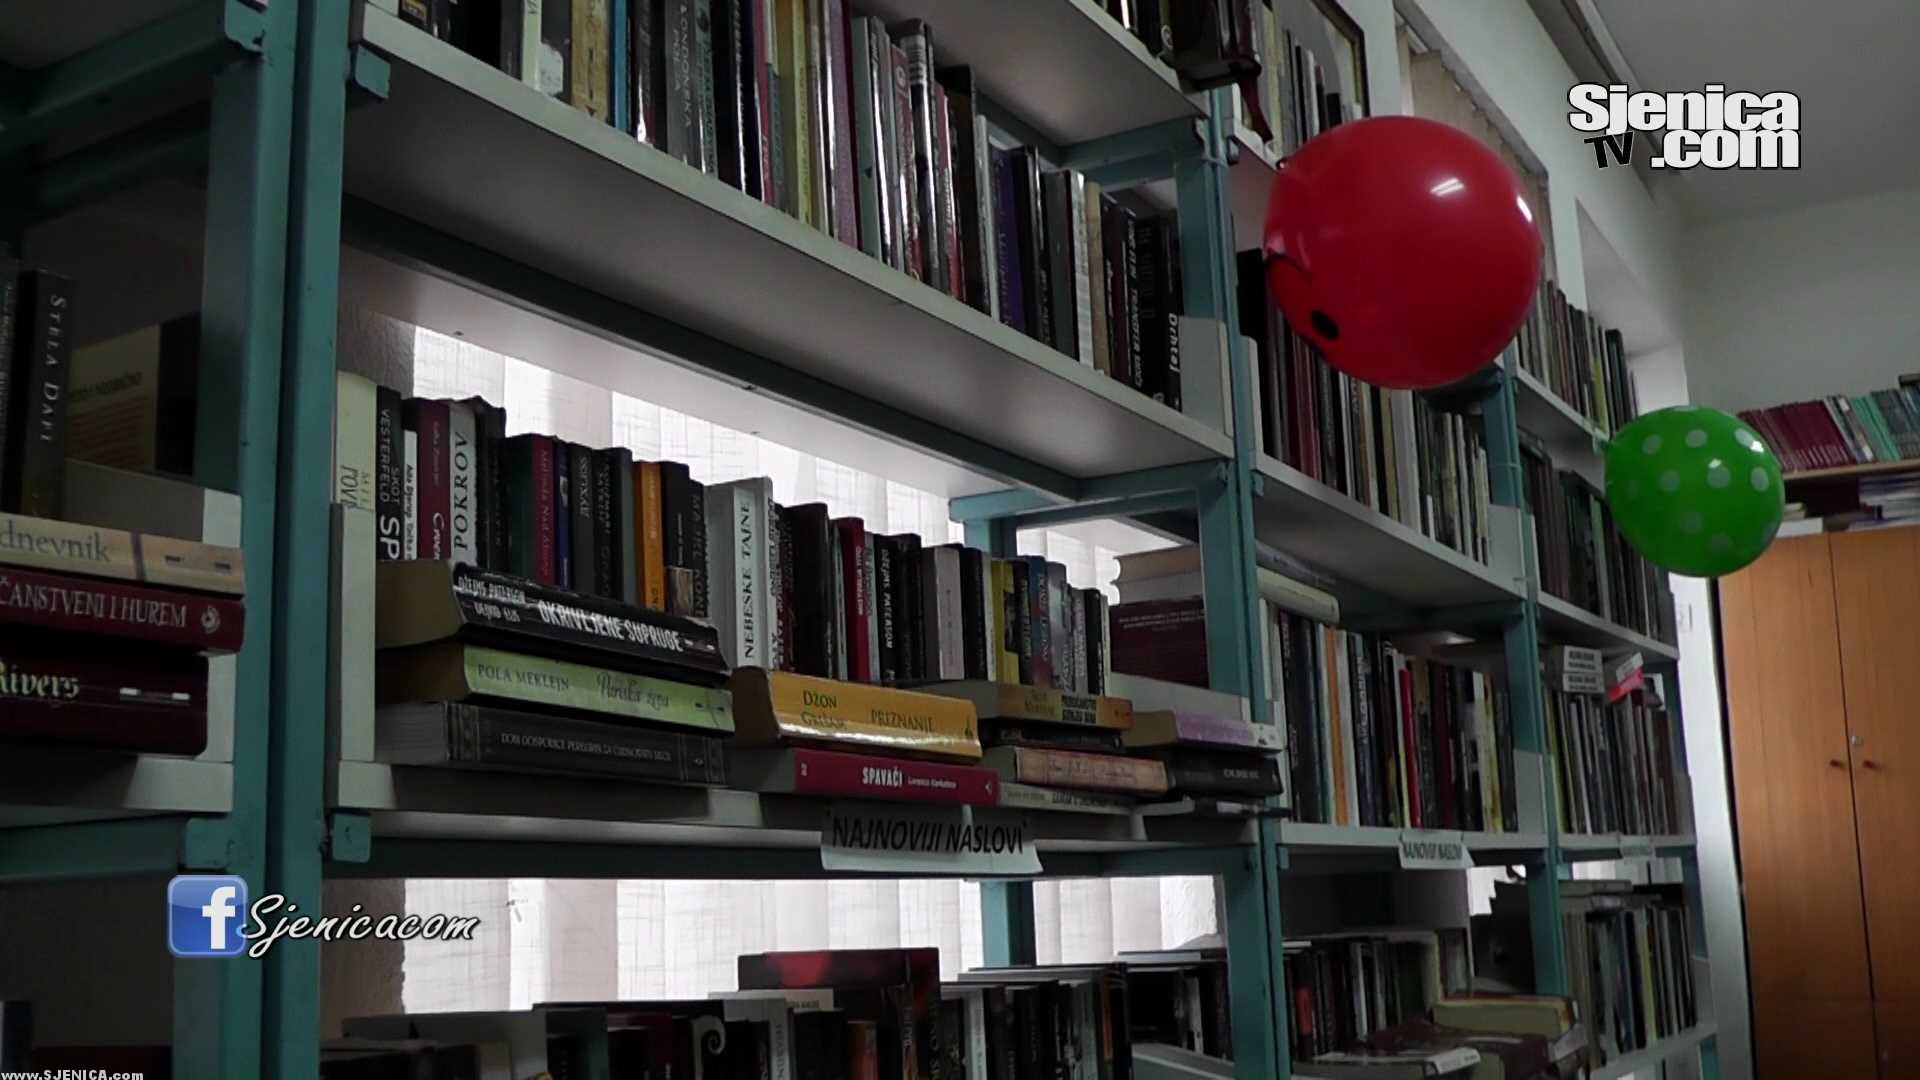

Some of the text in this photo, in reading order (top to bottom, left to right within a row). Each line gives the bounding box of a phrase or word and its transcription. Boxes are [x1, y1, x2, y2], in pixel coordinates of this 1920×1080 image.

[380, 409, 391, 503] VESTERFELD
[454, 432, 467, 550] POKROV
[0, 517, 111, 563] dnevnik
[740, 502, 754, 658] NEBESKE TAJNE
[120, 597, 187, 628] HUREM
[623, 620, 685, 652] SUPRUGE
[478, 663, 512, 683] POLA
[803, 689, 838, 709] DŽON
[870, 708, 936, 732] PRIZNANJE
[862, 765, 903, 788] SPAVAČI
[833, 815, 1023, 854] NAJNOVIJI NASLOVI
